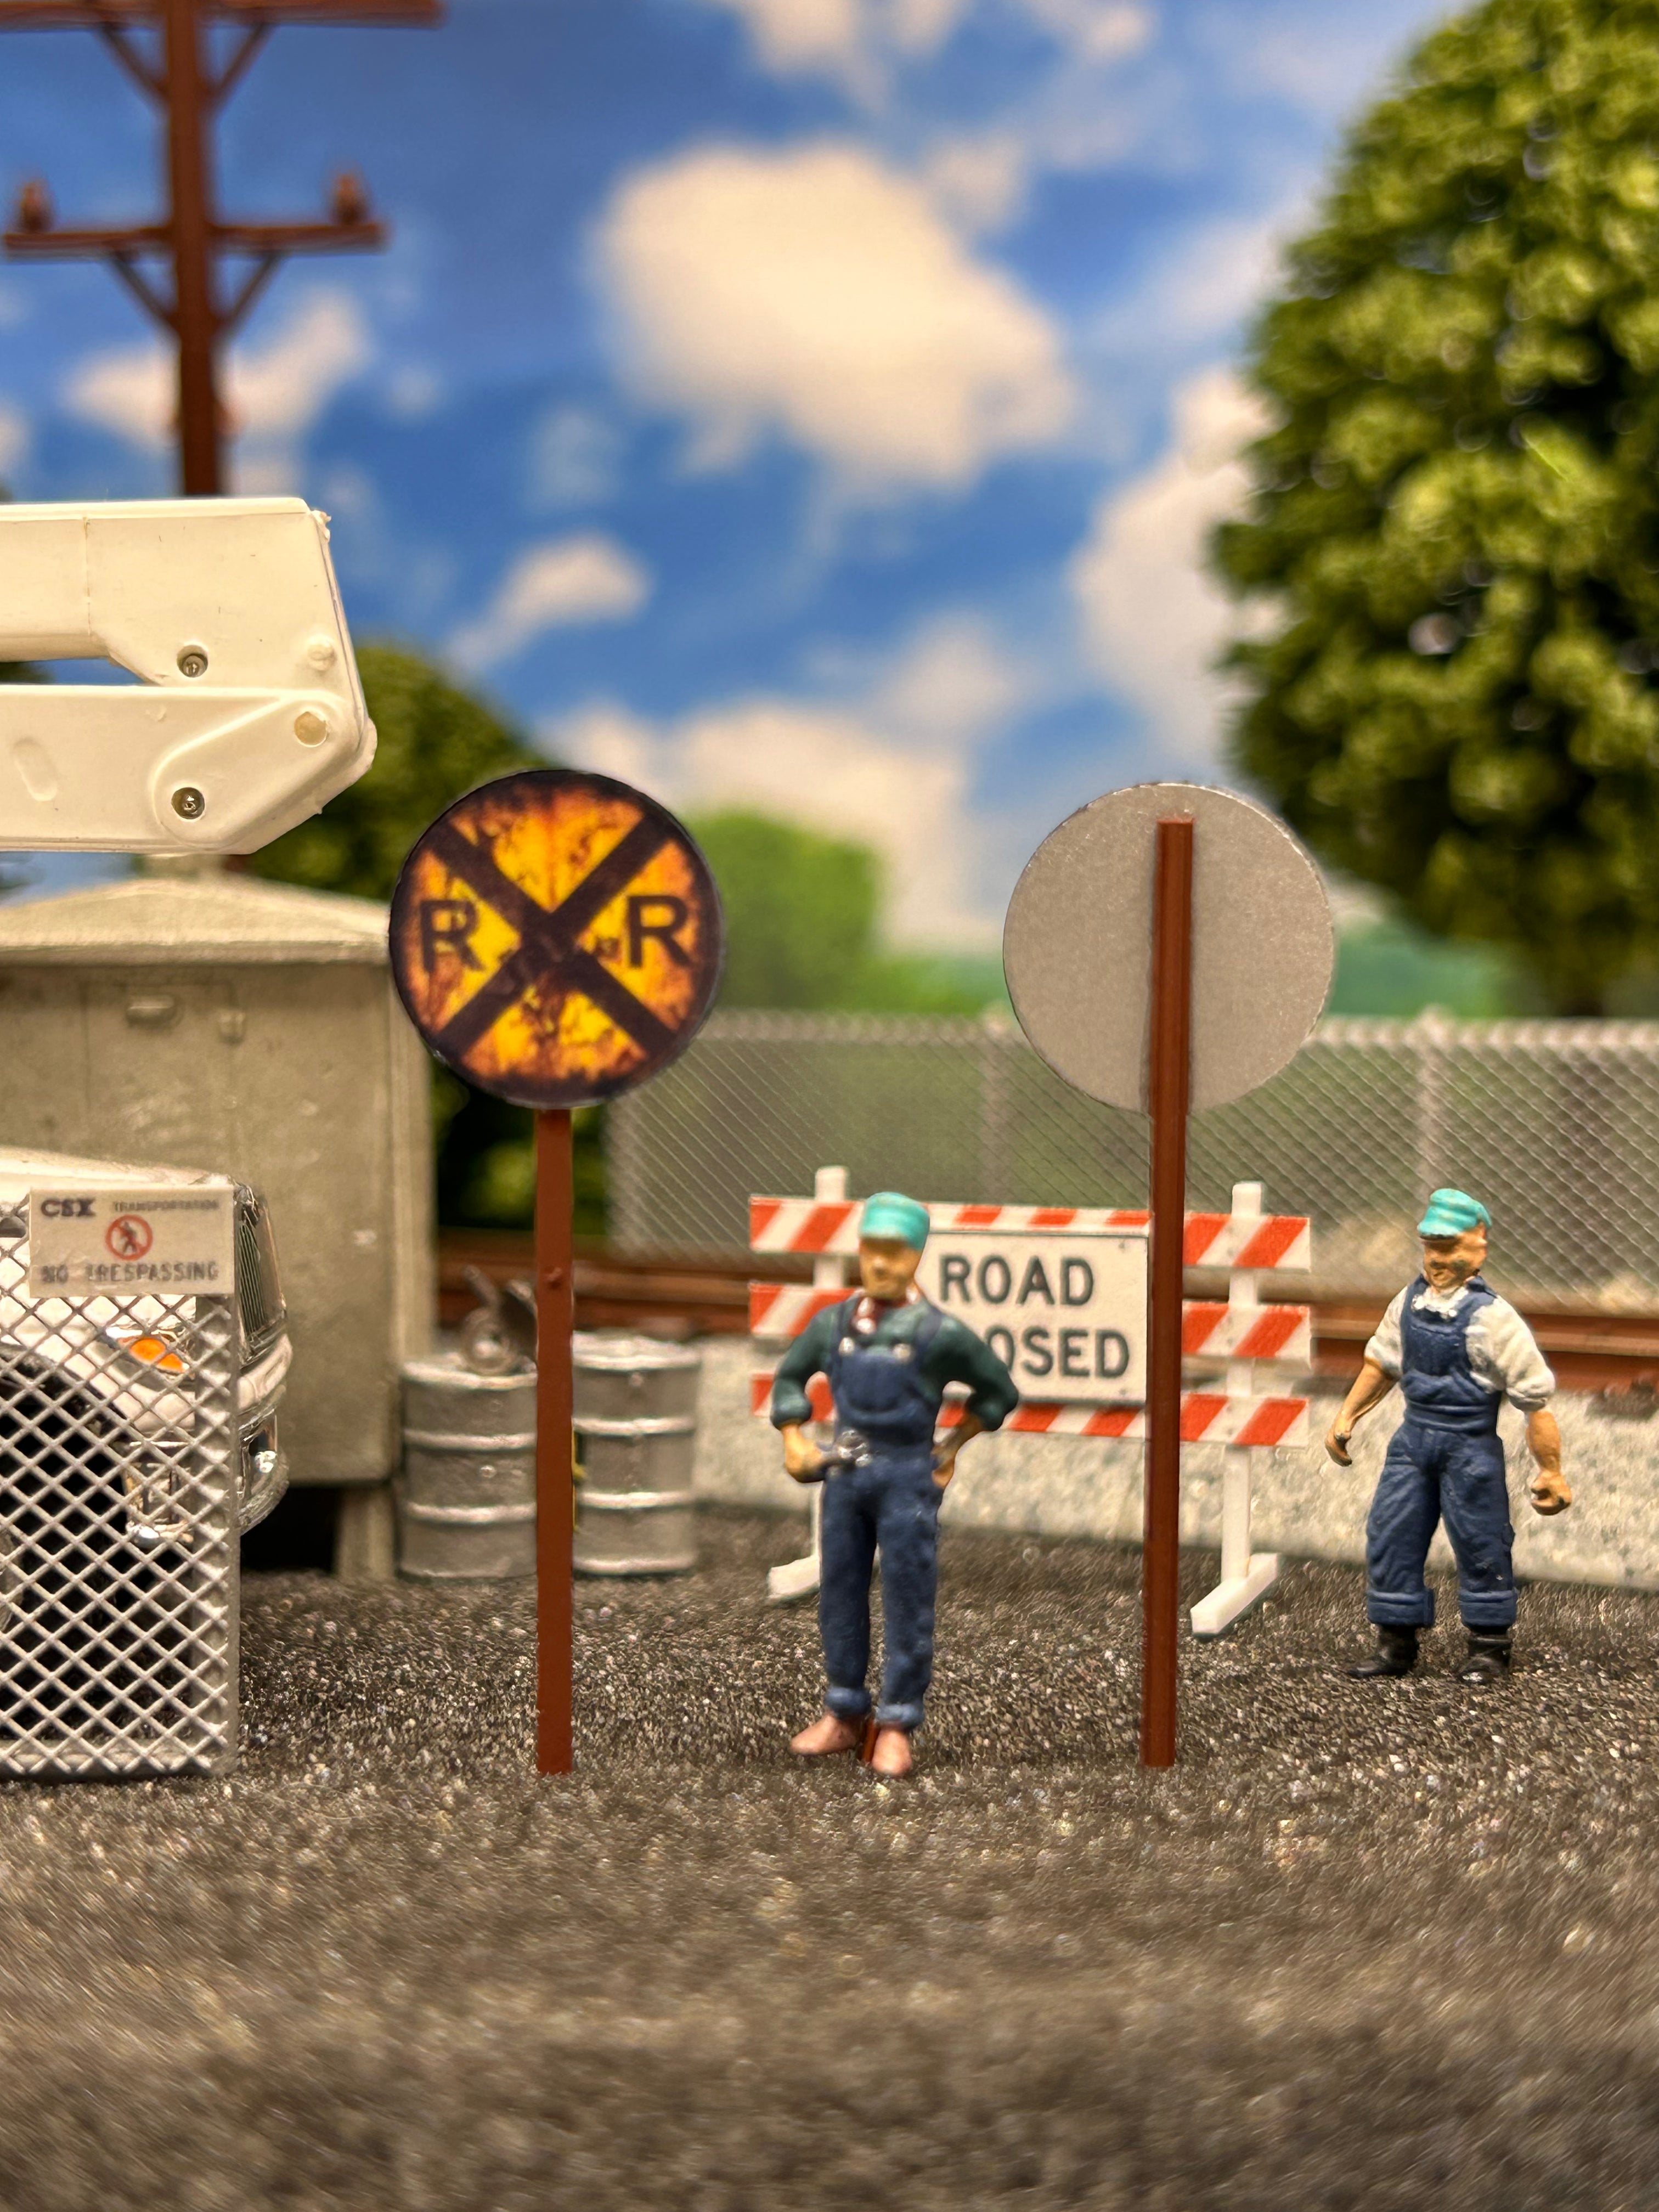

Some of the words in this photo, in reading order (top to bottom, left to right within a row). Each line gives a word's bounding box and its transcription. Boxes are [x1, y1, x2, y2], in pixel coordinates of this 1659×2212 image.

[420, 899, 486, 975] R
[628, 895, 693, 969] R
[41, 1198, 96, 1217] CSX
[41, 1265, 69, 1284] NO
[86, 1261, 219, 1283] TRESPASSING
[939, 1255, 1094, 1306] ROAD
[984, 1325, 1130, 1379] OSED
